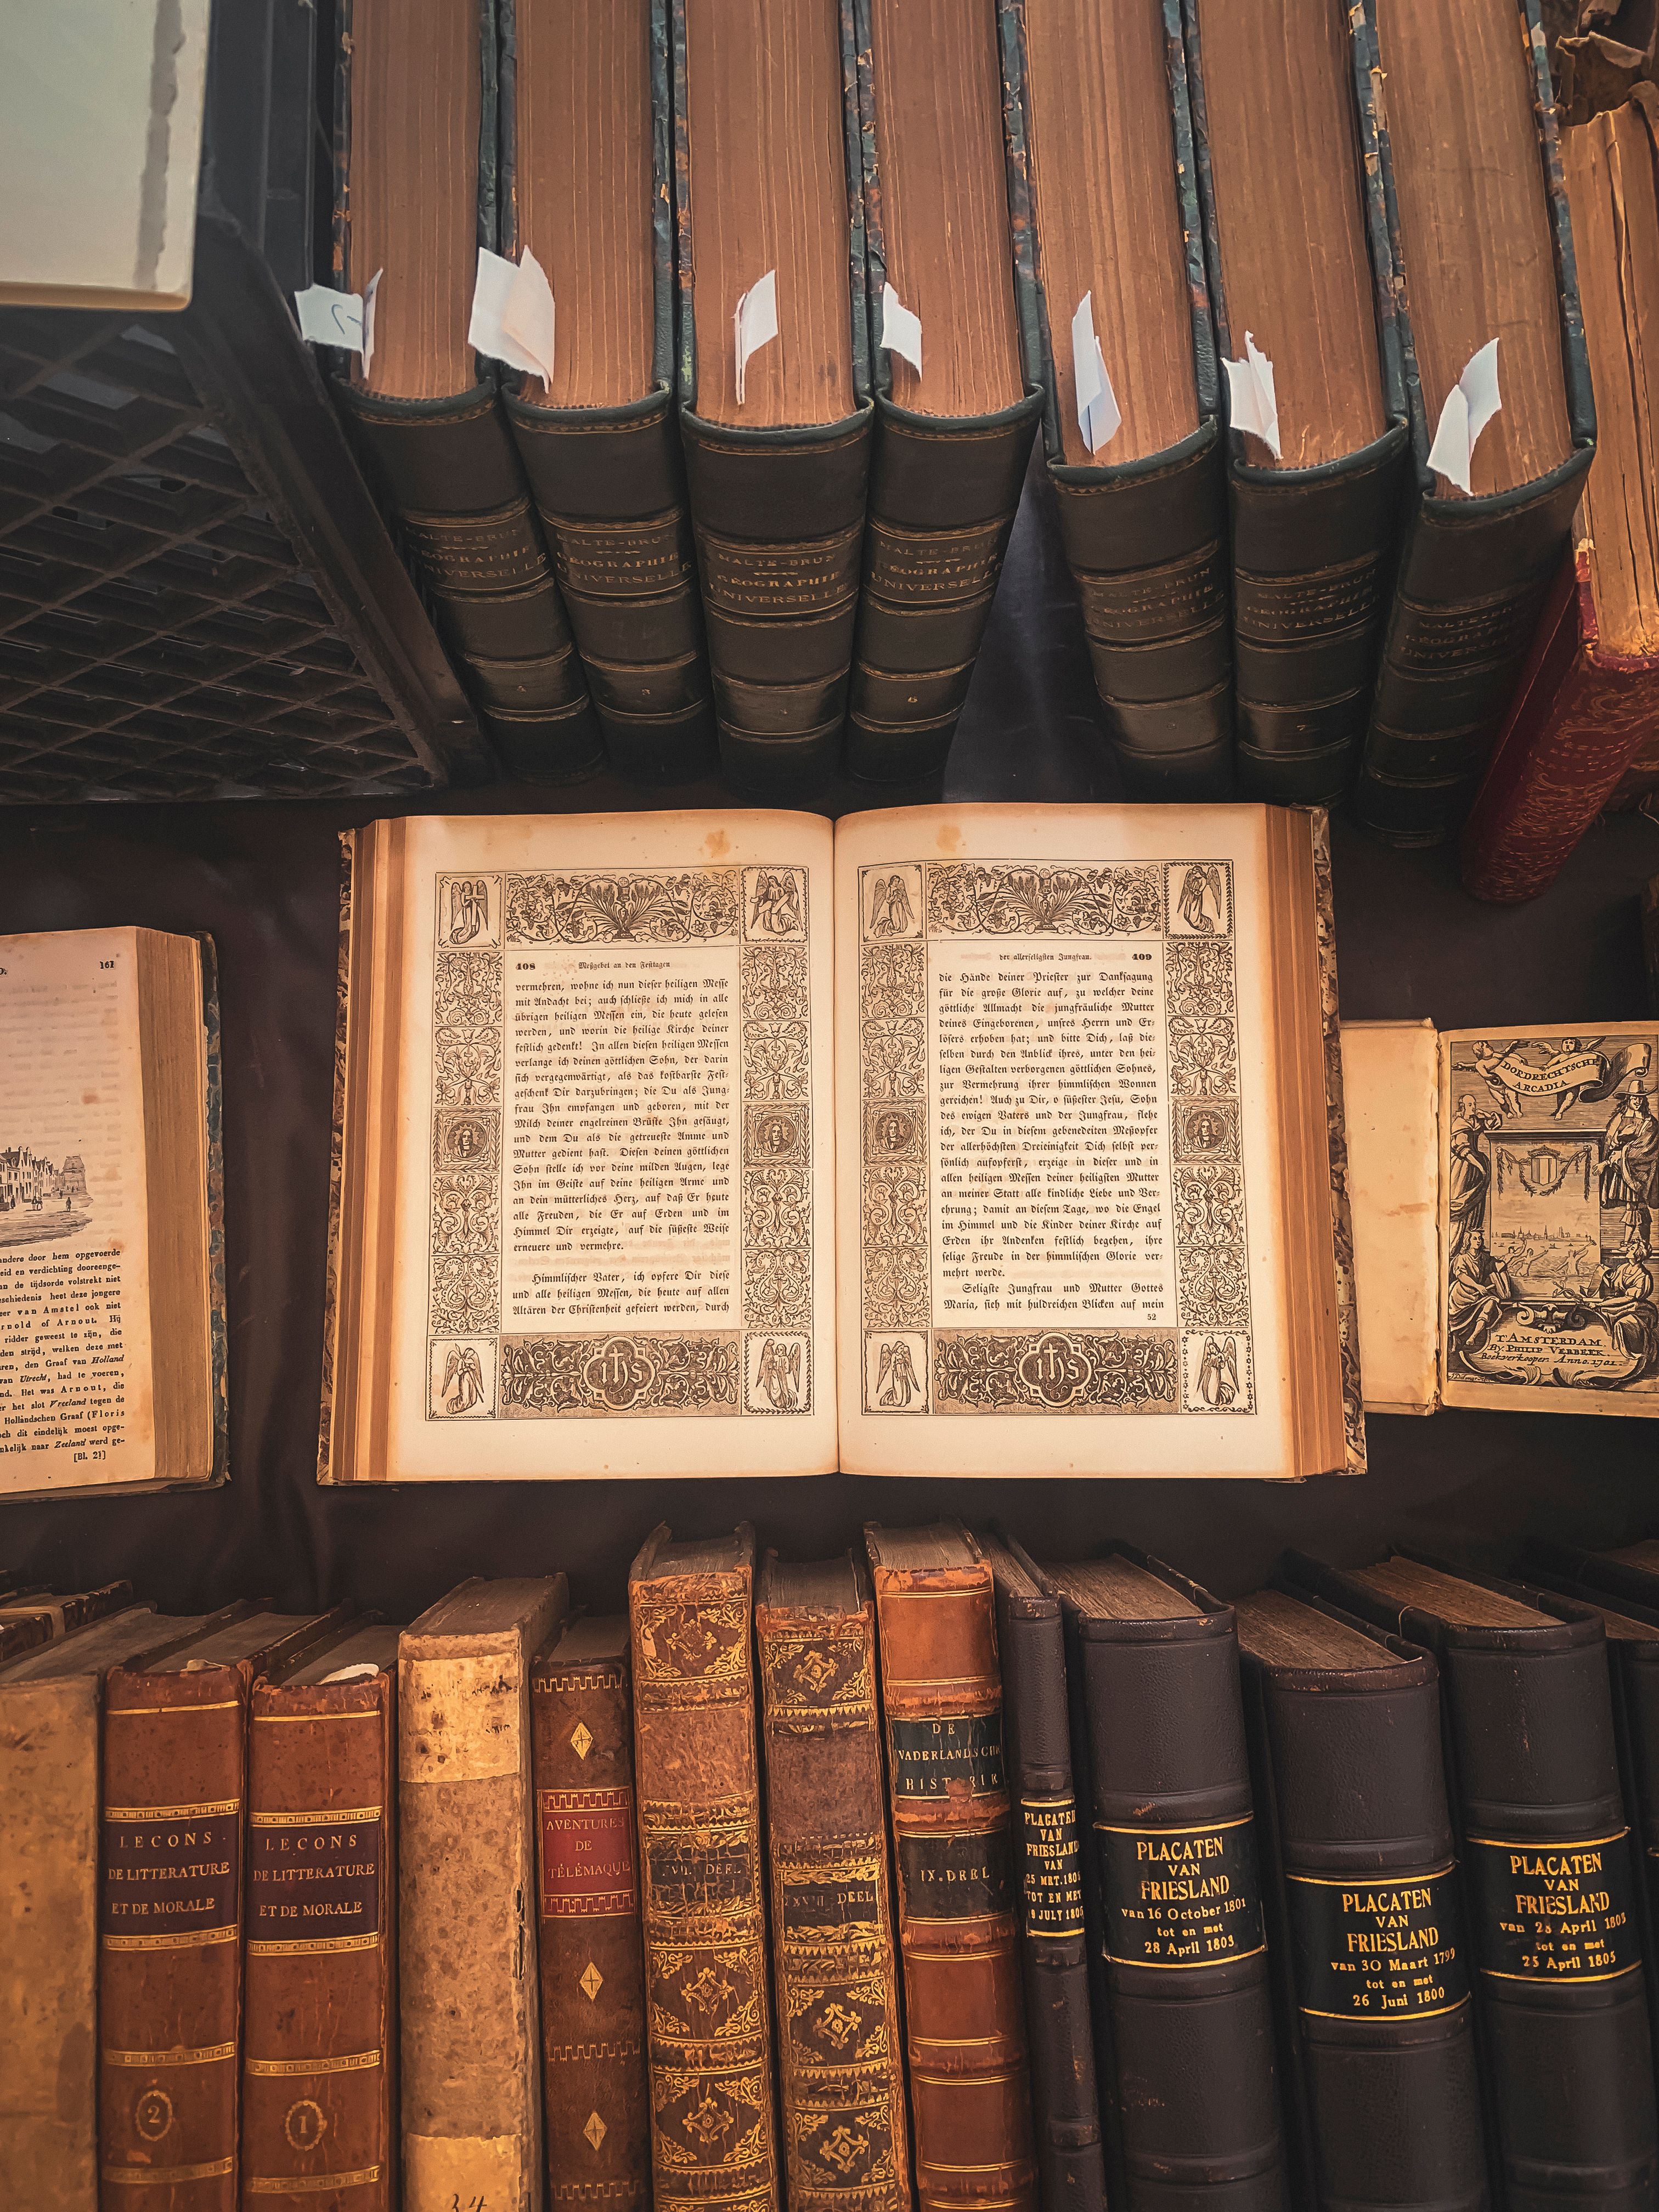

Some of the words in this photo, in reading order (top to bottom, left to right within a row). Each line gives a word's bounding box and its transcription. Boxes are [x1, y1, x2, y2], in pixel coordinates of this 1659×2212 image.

[99, 960, 114, 969] 161
[1058, 953, 1092, 962] Jungfrau.
[939, 988, 953, 999] für
[961, 987, 974, 997] die
[981, 988, 1006, 1000] große
[1012, 987, 1041, 997] Glorie
[1047, 988, 1068, 998] auf,
[1076, 990, 1086, 1000] zu
[1093, 986, 1126, 998] welcher
[1131, 986, 1154, 996] deine
[939, 1003, 975, 1015] göttliche
[983, 1002, 1022, 1014] Allmacht
[1031, 1002, 1045, 1012] die
[1054, 1002, 1113, 1014] jungfräuliche
[1121, 1002, 1155, 1012] Mutter
[1500, 1058, 1600, 1081] DORDRECHTSCHE
[1513, 1080, 1570, 1092] ARCADIA
[940, 1111, 956, 1120] des
[961, 1110, 991, 1122] ewigen
[997, 1110, 1029, 1120] Vaters
[1035, 1110, 1052, 1120] und
[1058, 1111, 1073, 1119] der
[1079, 1110, 1128, 1122] Jungfrau,
[529, 1194, 548, 1204] dein
[554, 1193, 607, 1205] mütterliches
[613, 1193, 639, 1206] Herz,
[645, 1193, 662, 1204] auf
[687, 1192, 700, 1202] Er
[706, 1192, 729, 1202] heute
[556, 1242, 573, 1251] und
[580, 1240, 624, 1252] vermehre.
[28, 1253, 47, 1261] door
[52, 1252, 70, 1260] hem
[75, 1248, 121, 1261] opgevoerde
[943, 1267, 969, 1279] mehrt
[975, 1268, 1005, 1277] werde.
[14, 1281, 24, 1289] de
[67, 1276, 102, 1285] volstrekt
[105, 1274, 121, 1283] niet
[70, 1290, 88, 1299] deze
[91, 1289, 121, 1300] jongere
[4, 1334, 29, 1344] ridder
[35, 1333, 65, 1344] geweest
[110, 1328, 122, 1336] die
[24, 1361, 39, 1369] den
[45, 1357, 68, 1368] Graaf
[91, 1354, 125, 1364] Holland
[12, 1402, 25, 1410] het
[31, 1401, 45, 1409] slot
[89, 1398, 112, 1407] tegen
[115, 1395, 125, 1403] de
[933, 1723, 955, 1735] DE
[546, 1817, 625, 1831] AVENTURES
[1025, 1810, 1076, 1826] PLACATEN
[1040, 1828, 1063, 1842] VAN
[574, 1840, 592, 1852] DE
[1136, 1837, 1223, 1861] PLACATEN
[548, 1860, 630, 1879] TÉLÉMAQUE
[1044, 1858, 1063, 1871] VAN
[1168, 1863, 1200, 1876] VAN
[1510, 1852, 1602, 1875] PLACATEN
[109, 1868, 123, 1880] DE
[127, 1862, 230, 1881] LITTERATURE
[253, 1870, 269, 1881] DE
[273, 1864, 375, 1882] LITTERATURE
[1026, 1874, 1036, 1884] 25
[1141, 1875, 1229, 1900] FRIESLAND
[1544, 1878, 1579, 1891] VAN
[837, 1891, 873, 1904] DEEL
[1026, 1891, 1043, 1903] TOT
[1048, 1891, 1061, 1903] EN
[1066, 1891, 1081, 1902] MET
[1342, 1888, 1432, 1912] PLACATEN
[1515, 1892, 1610, 1915] FRIESLAND
[112, 1903, 128, 1915] ET
[133, 1903, 149, 1915] DE
[154, 1898, 215, 1914] MORALE
[259, 1905, 277, 1917] ET
[280, 1906, 298, 1917] DE
[303, 1901, 363, 1916] MORALE
[1121, 1908, 1144, 1918] van
[1148, 1908, 1161, 1919] 16
[1167, 1905, 1221, 1920] October
[1224, 1898, 1246, 1914] 1801
[1039, 1909, 1064, 1921] JULY
[1375, 1915, 1409, 1928] VAN
[1157, 1927, 1175, 1937] tot
[1182, 1928, 1196, 1936] en
[1204, 1923, 1223, 1934] met
[1499, 1922, 1525, 1932] van
[1560, 1920, 1597, 1935] April
[1144, 1942, 1160, 1954] 28
[1167, 1941, 1200, 1957] April
[1206, 1934, 1234, 1951] 1803
[1347, 1927, 1438, 1952] FRIESLAND
[1536, 1942, 1555, 1951] tot
[1562, 1943, 1576, 1951] en
[1584, 1939, 1605, 1950] met
[1331, 1962, 1356, 1971] van
[1362, 1959, 1381, 1971] 30
[1389, 1956, 1429, 1971] Maart
[1522, 1955, 1539, 1968] 25
[1547, 1957, 1581, 1971] April
[1588, 1950, 1616, 1967] 1805
[1366, 1979, 1384, 1989] tot
[1392, 1980, 1406, 1988] en
[1413, 1974, 1433, 1986] met
[1353, 1994, 1369, 2006] 26
[1381, 1994, 1408, 2010] Juni
[1417, 1987, 1444, 2004] 1800
[147, 2106, 161, 2124] 2
[299, 2115, 308, 2134] 1
